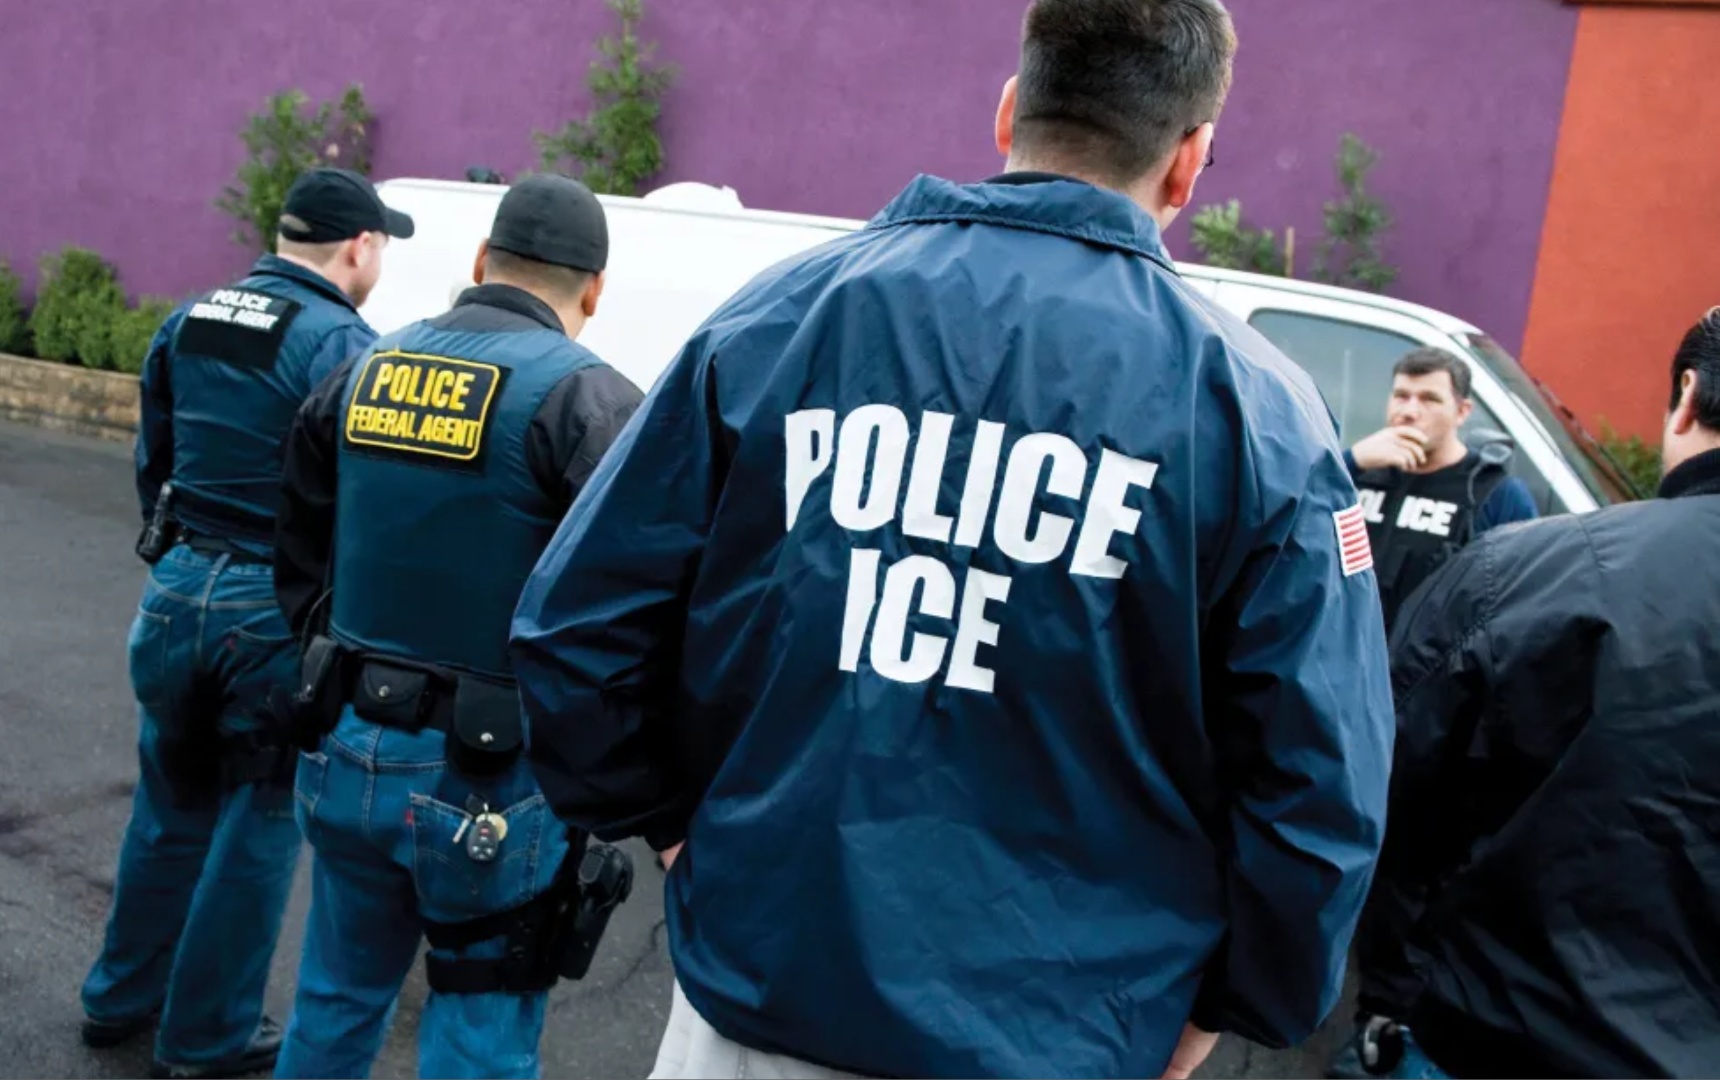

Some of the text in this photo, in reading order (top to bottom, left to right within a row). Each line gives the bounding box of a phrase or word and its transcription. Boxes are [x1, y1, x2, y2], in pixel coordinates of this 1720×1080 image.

[211, 289, 273, 312] POLICE
[370, 363, 476, 411] POLICE
[350, 405, 480, 449] FEDERAL AGENT
[785, 403, 1159, 579] POLICE
[839, 548, 1012, 693] ICE
